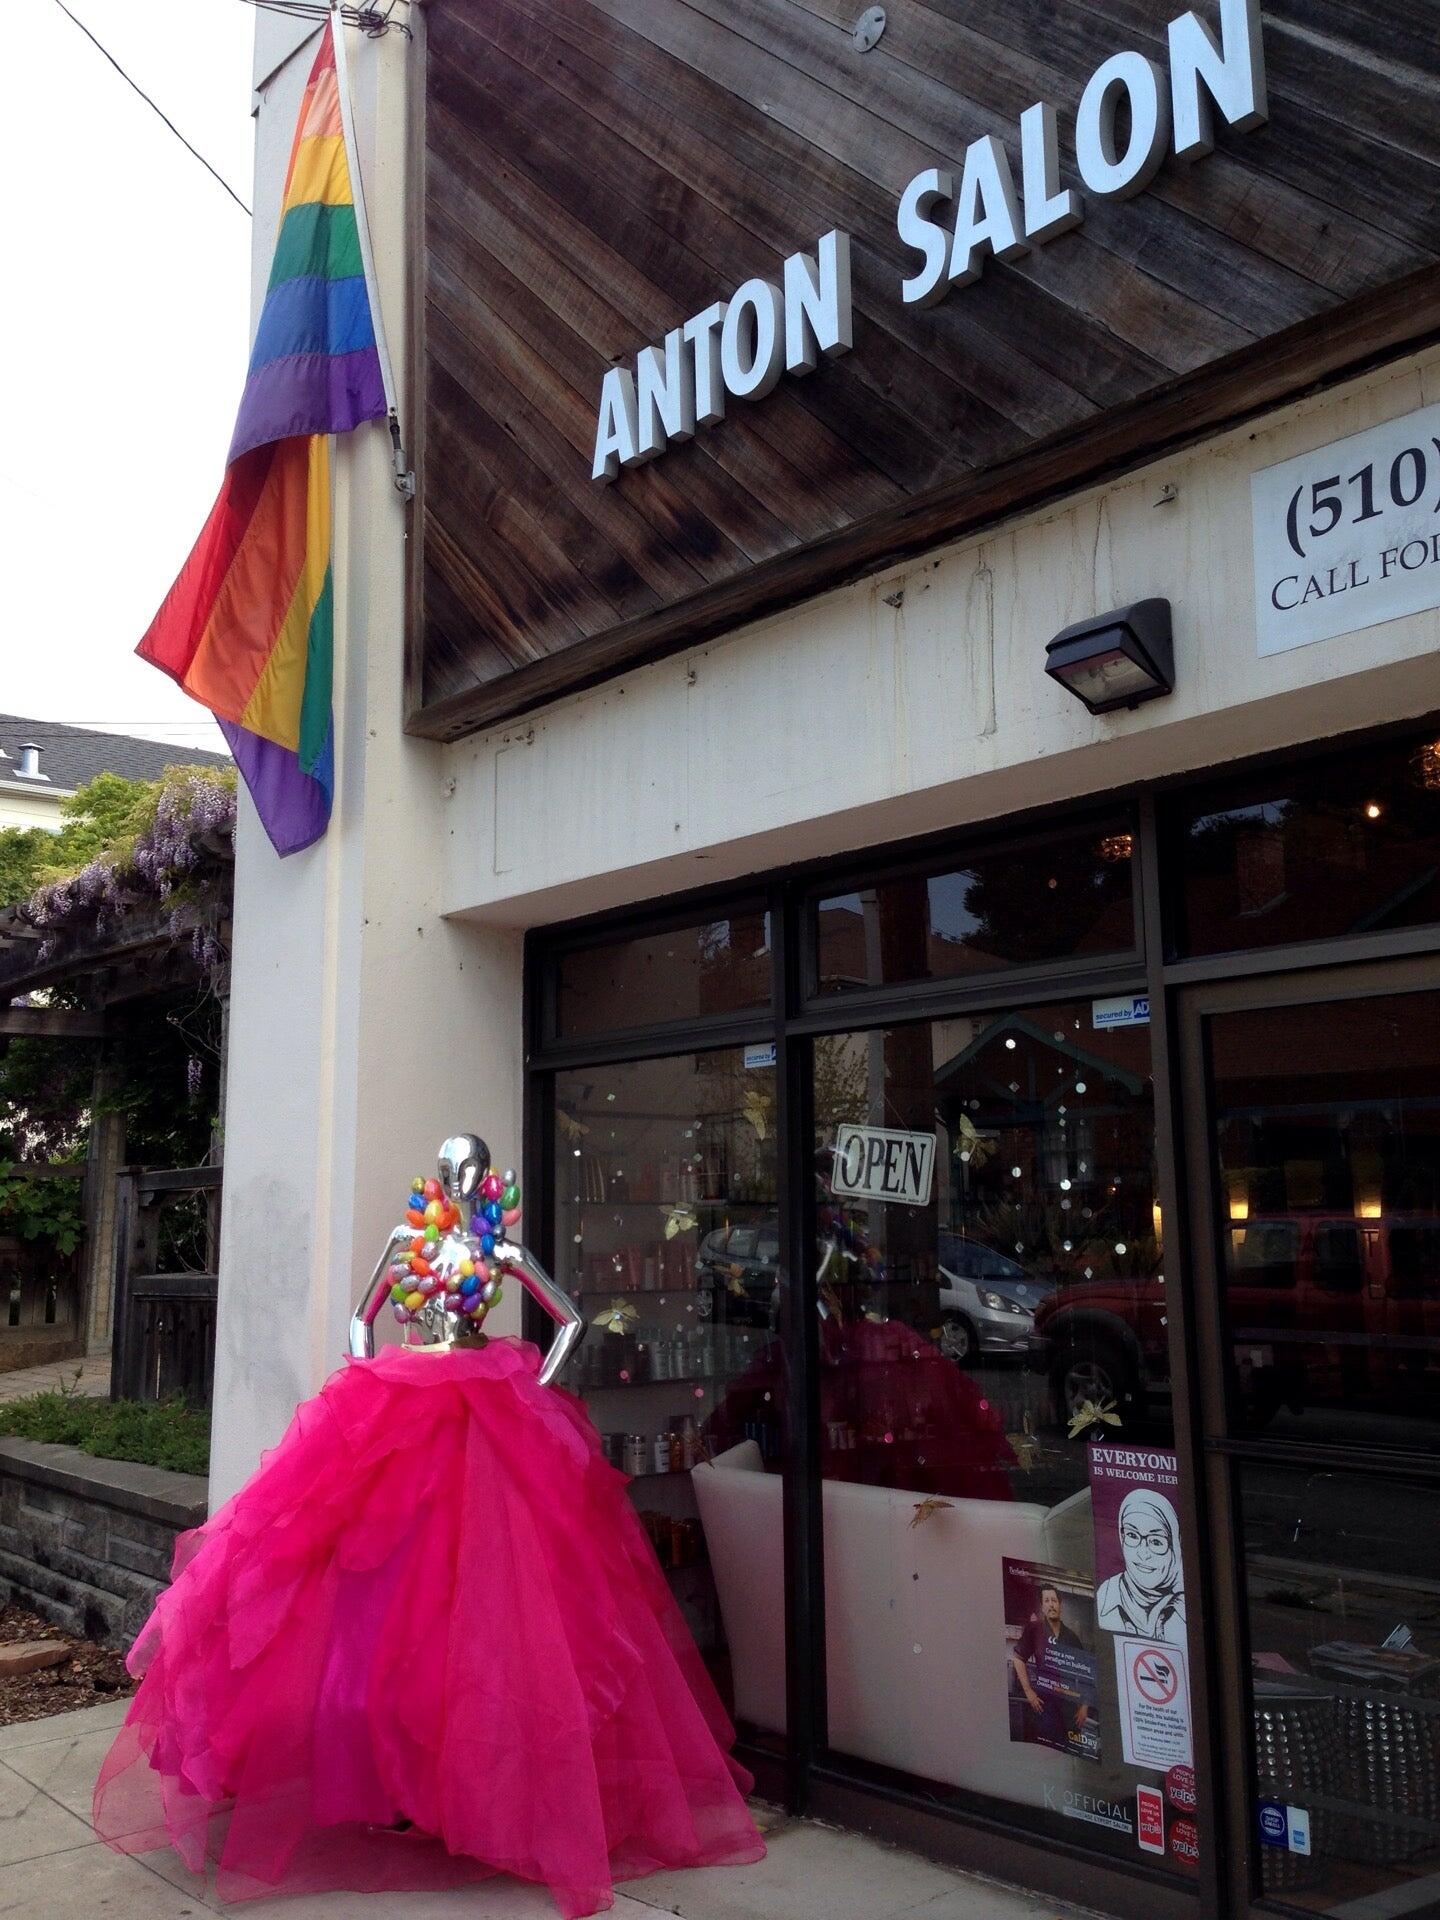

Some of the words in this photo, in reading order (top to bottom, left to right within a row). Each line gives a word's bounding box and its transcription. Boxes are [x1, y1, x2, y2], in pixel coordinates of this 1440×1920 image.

[592, 229, 852, 482] ANTON
[897, 0, 1268, 307] SALON
[1271, 560, 1369, 611] CALL
[841, 1134, 927, 1196] OPEN
[1093, 1466, 1104, 1476] IS
[1106, 1467, 1155, 1482] WELCOME
[1063, 1790, 1133, 1823] OFFICIAL
